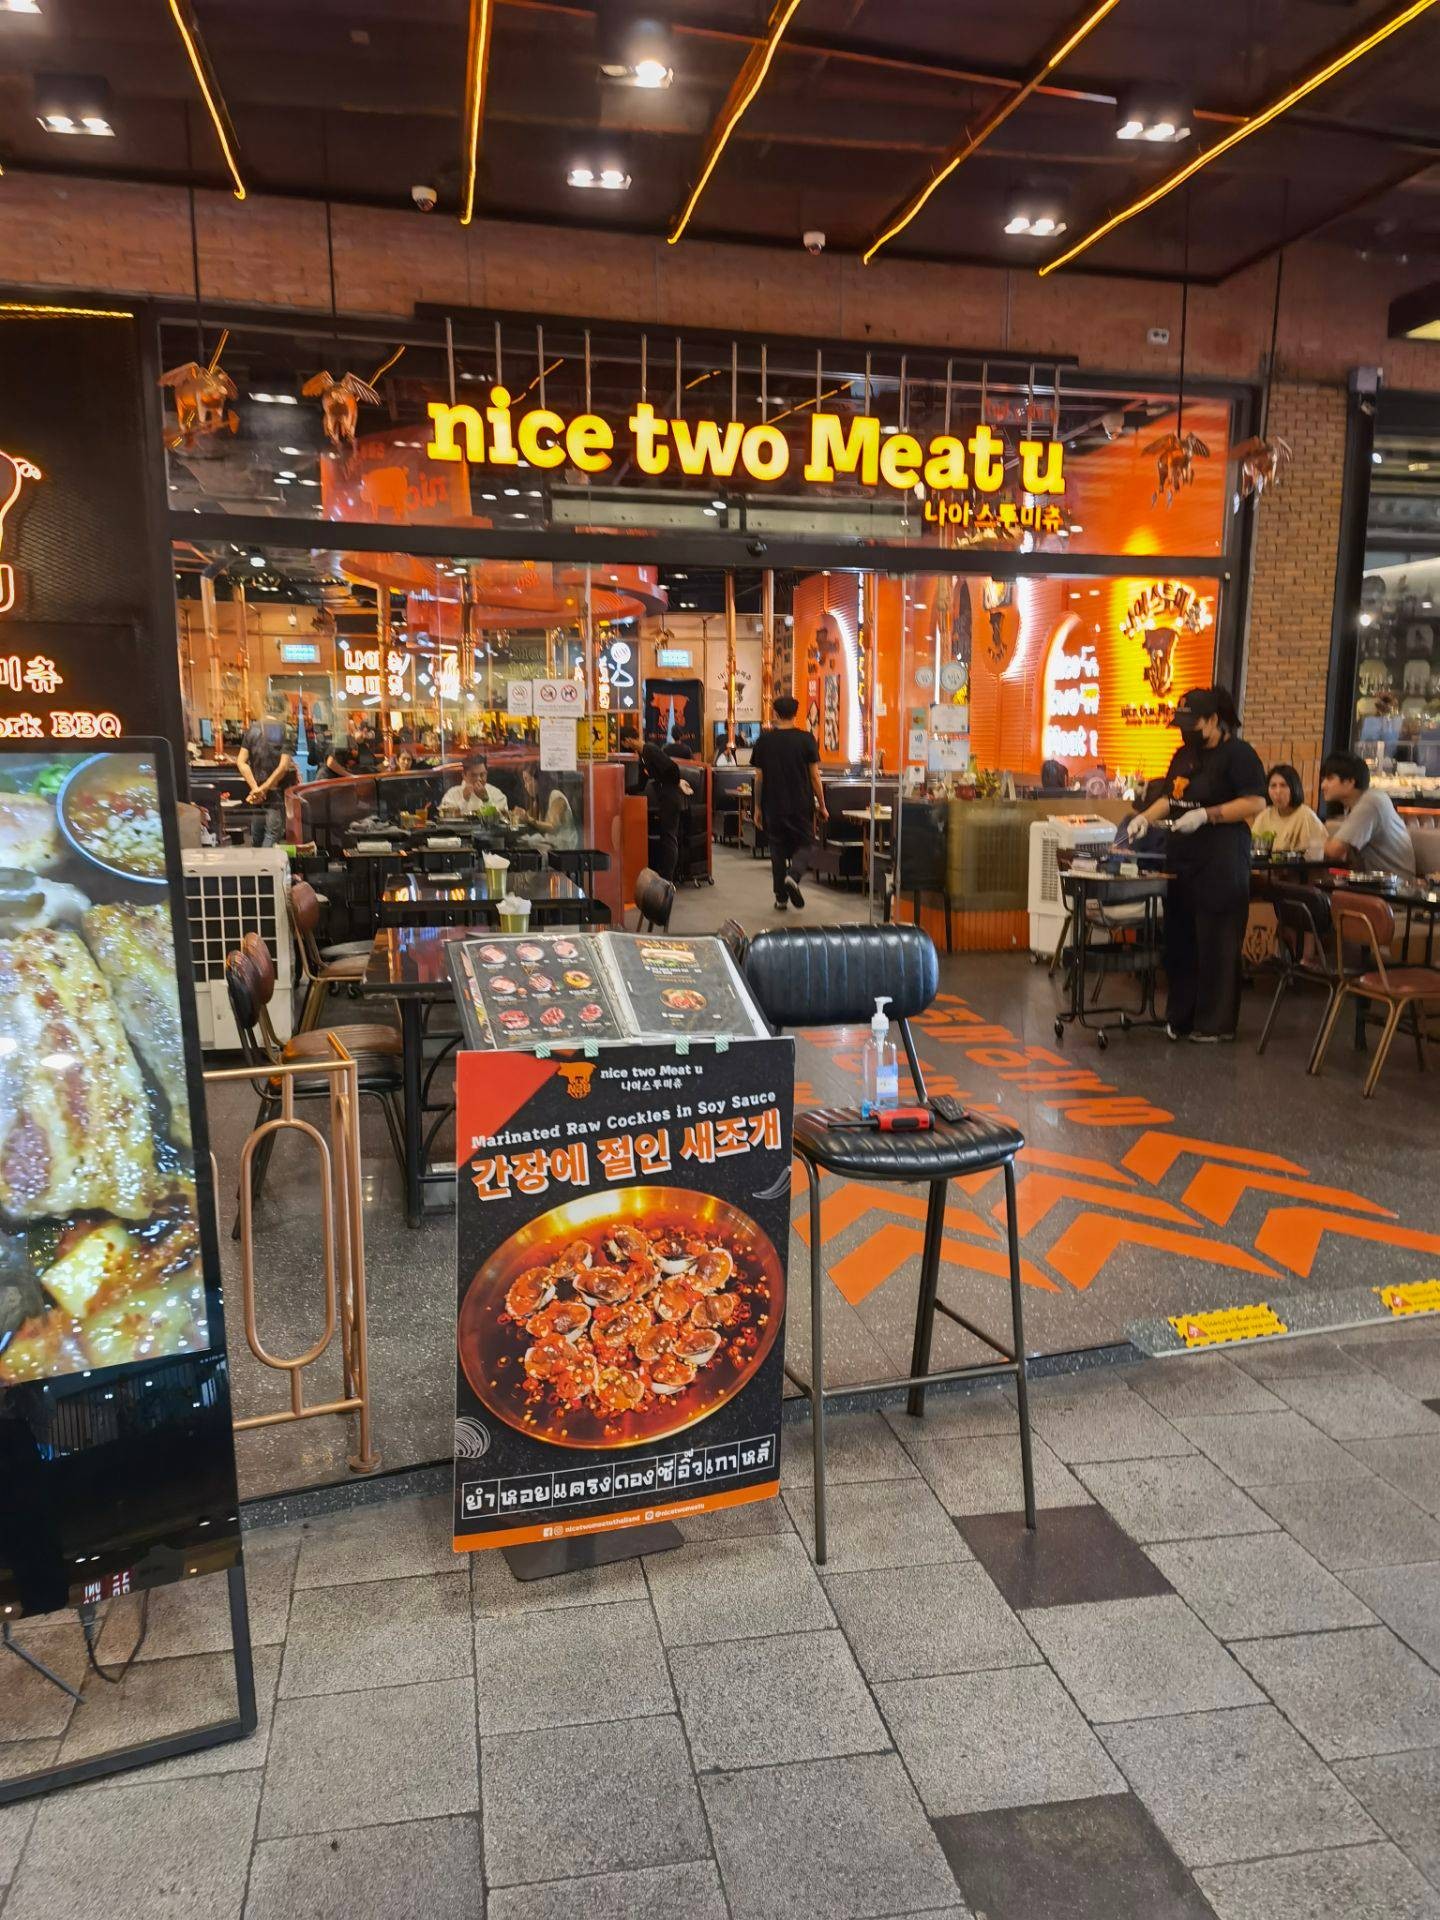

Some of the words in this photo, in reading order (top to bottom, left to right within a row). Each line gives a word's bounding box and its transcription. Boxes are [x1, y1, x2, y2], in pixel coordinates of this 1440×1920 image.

[427, 385, 614, 473] nice
[628, 402, 790, 481] two
[803, 412, 1004, 493] Meat
[1019, 440, 1066, 495] u
[49, 711, 122, 739] BBQ
[600, 1066, 628, 1080] nice
[631, 1066, 656, 1079] two
[659, 1064, 692, 1076] Meat
[694, 1065, 703, 1075] u
[471, 1124, 561, 1149] Marinated
[566, 1118, 601, 1136] Raw
[606, 1109, 671, 1130] Cockles
[676, 1104, 692, 1119] in
[698, 1099, 726, 1117] Soy
[731, 1090, 777, 1109] Sauce
[471, 1142, 590, 1200] 간장에
[597, 1128, 672, 1182] 절인
[680, 1108, 782, 1164] 새조개
